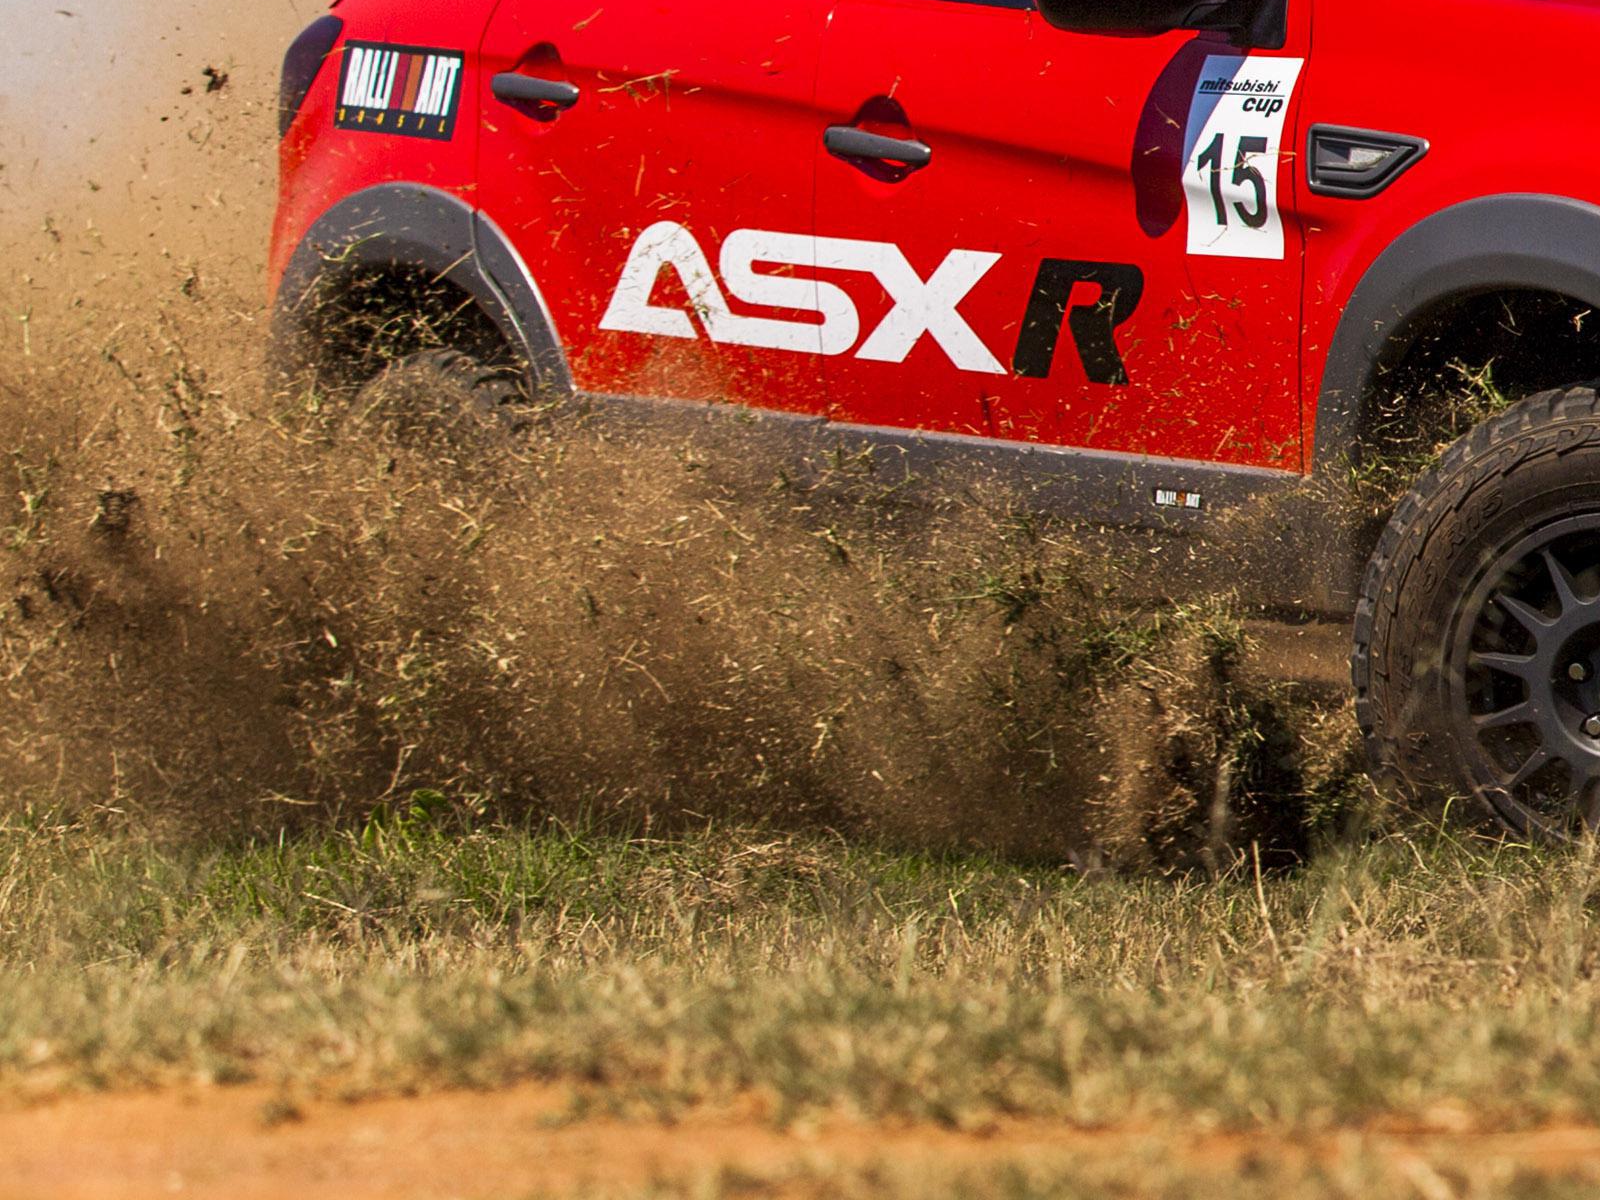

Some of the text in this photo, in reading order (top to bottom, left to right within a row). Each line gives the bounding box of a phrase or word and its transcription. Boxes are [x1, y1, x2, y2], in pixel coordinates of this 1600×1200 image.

[1199, 77, 1280, 93] mitsubishi
[1242, 96, 1284, 118] cup
[1197, 132, 1269, 229] 15
[597, 220, 1145, 385] ASX R
